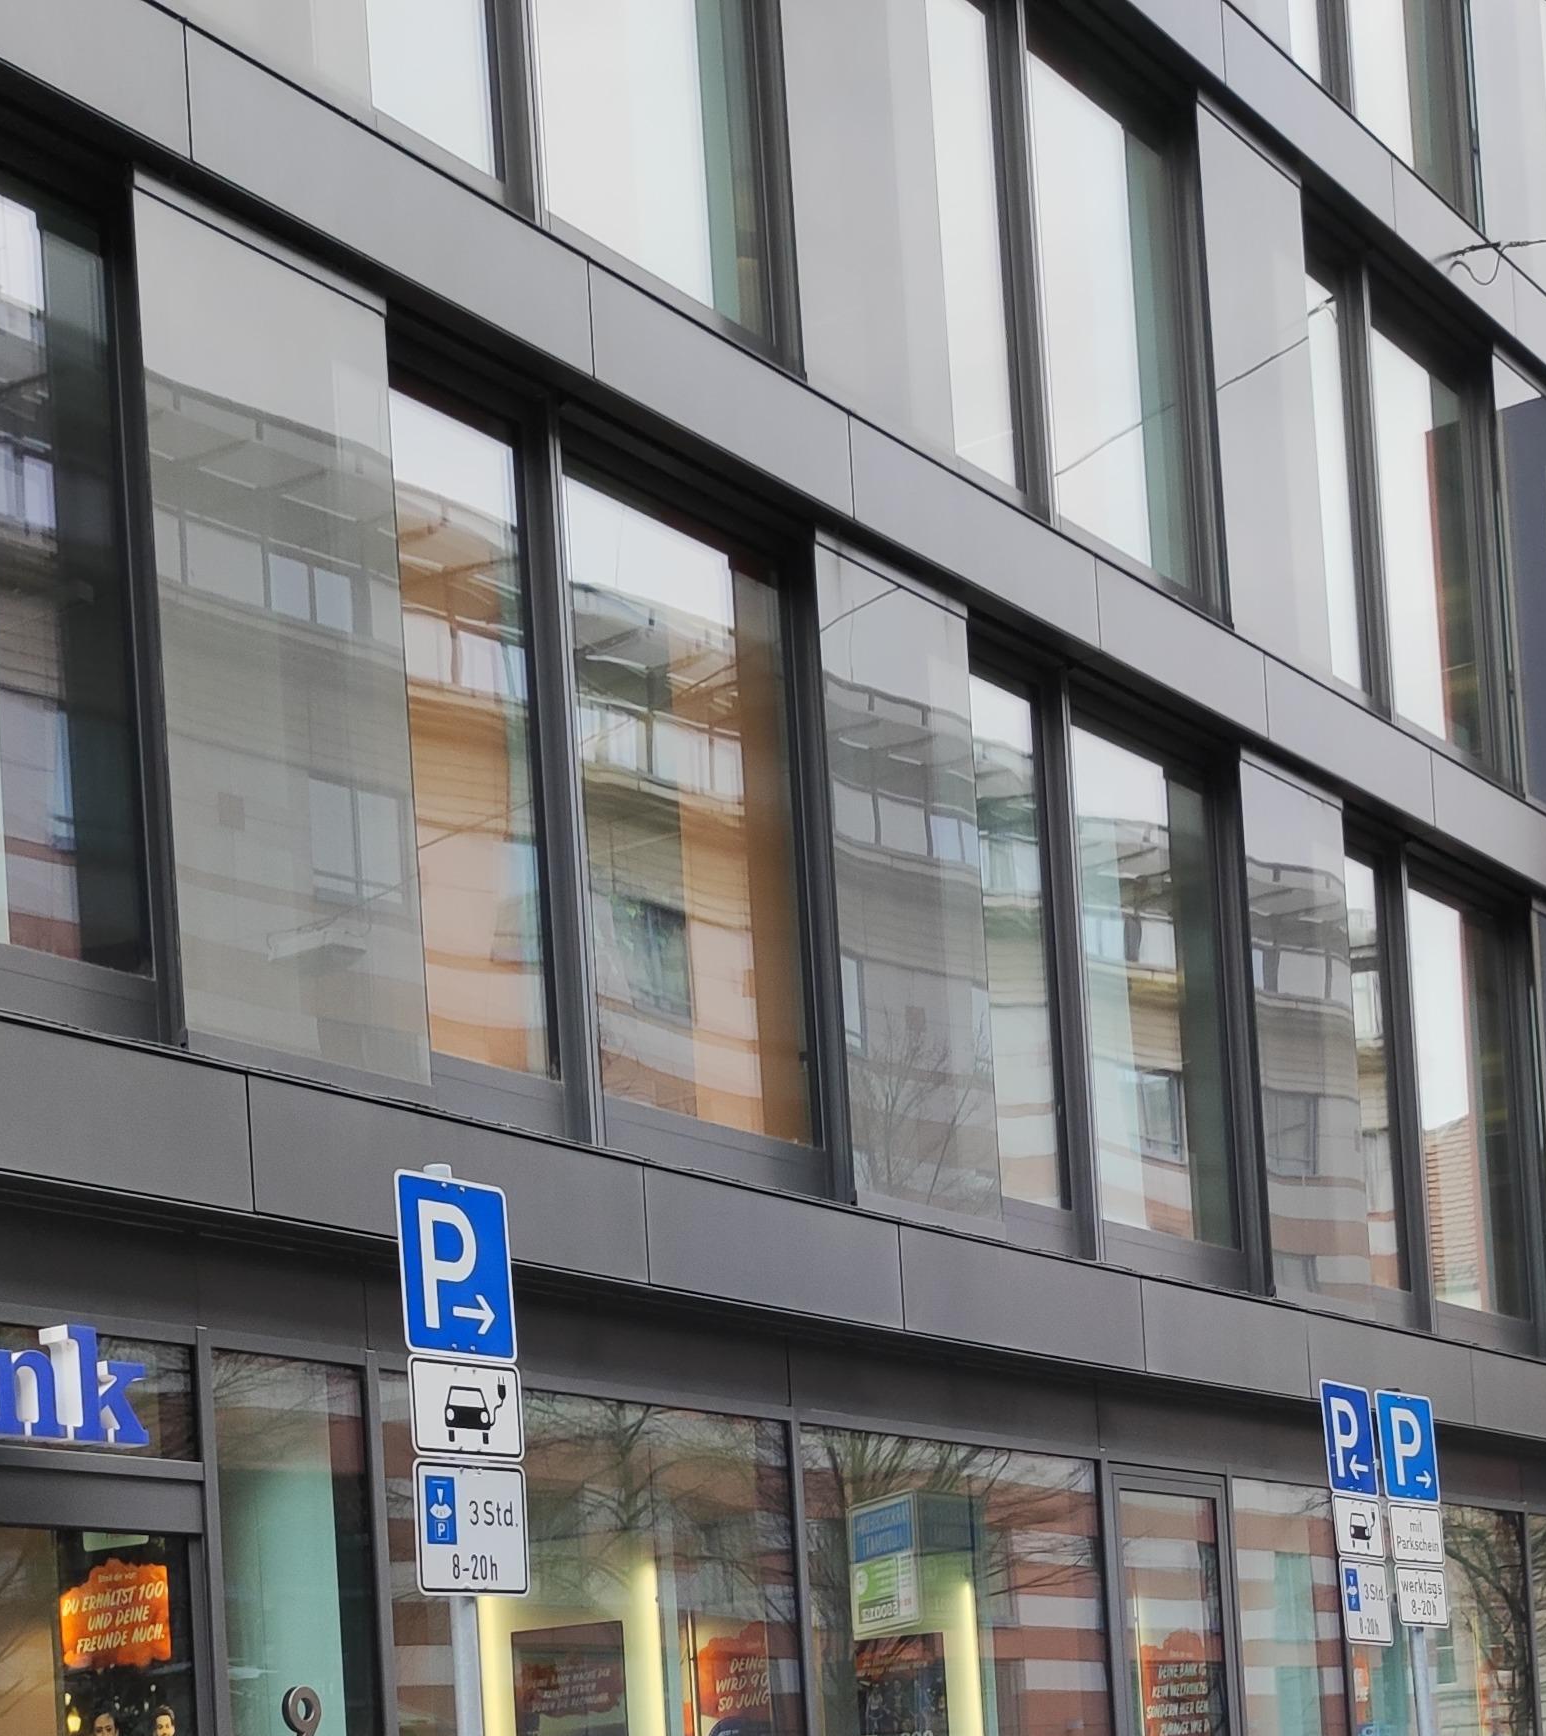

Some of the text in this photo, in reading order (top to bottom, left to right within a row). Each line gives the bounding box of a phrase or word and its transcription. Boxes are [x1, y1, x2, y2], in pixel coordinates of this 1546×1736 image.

[417, 1198, 477, 1329] P
[1330, 1396, 1358, 1478] P
[1390, 1407, 1422, 1486] P
[1409, 1521, 1422, 1533] mit
[1397, 1535, 1439, 1553] Parkschein
[62, 1599, 79, 1617] DU
[138, 1581, 168, 1601] 100
[1401, 1578, 1442, 1600] werktags
[88, 1605, 150, 1632] UND DEINE
[77, 1631, 128, 1653] FREUNDE
[716, 1676, 747, 1694] WIRD
[718, 1697, 734, 1712] SO
